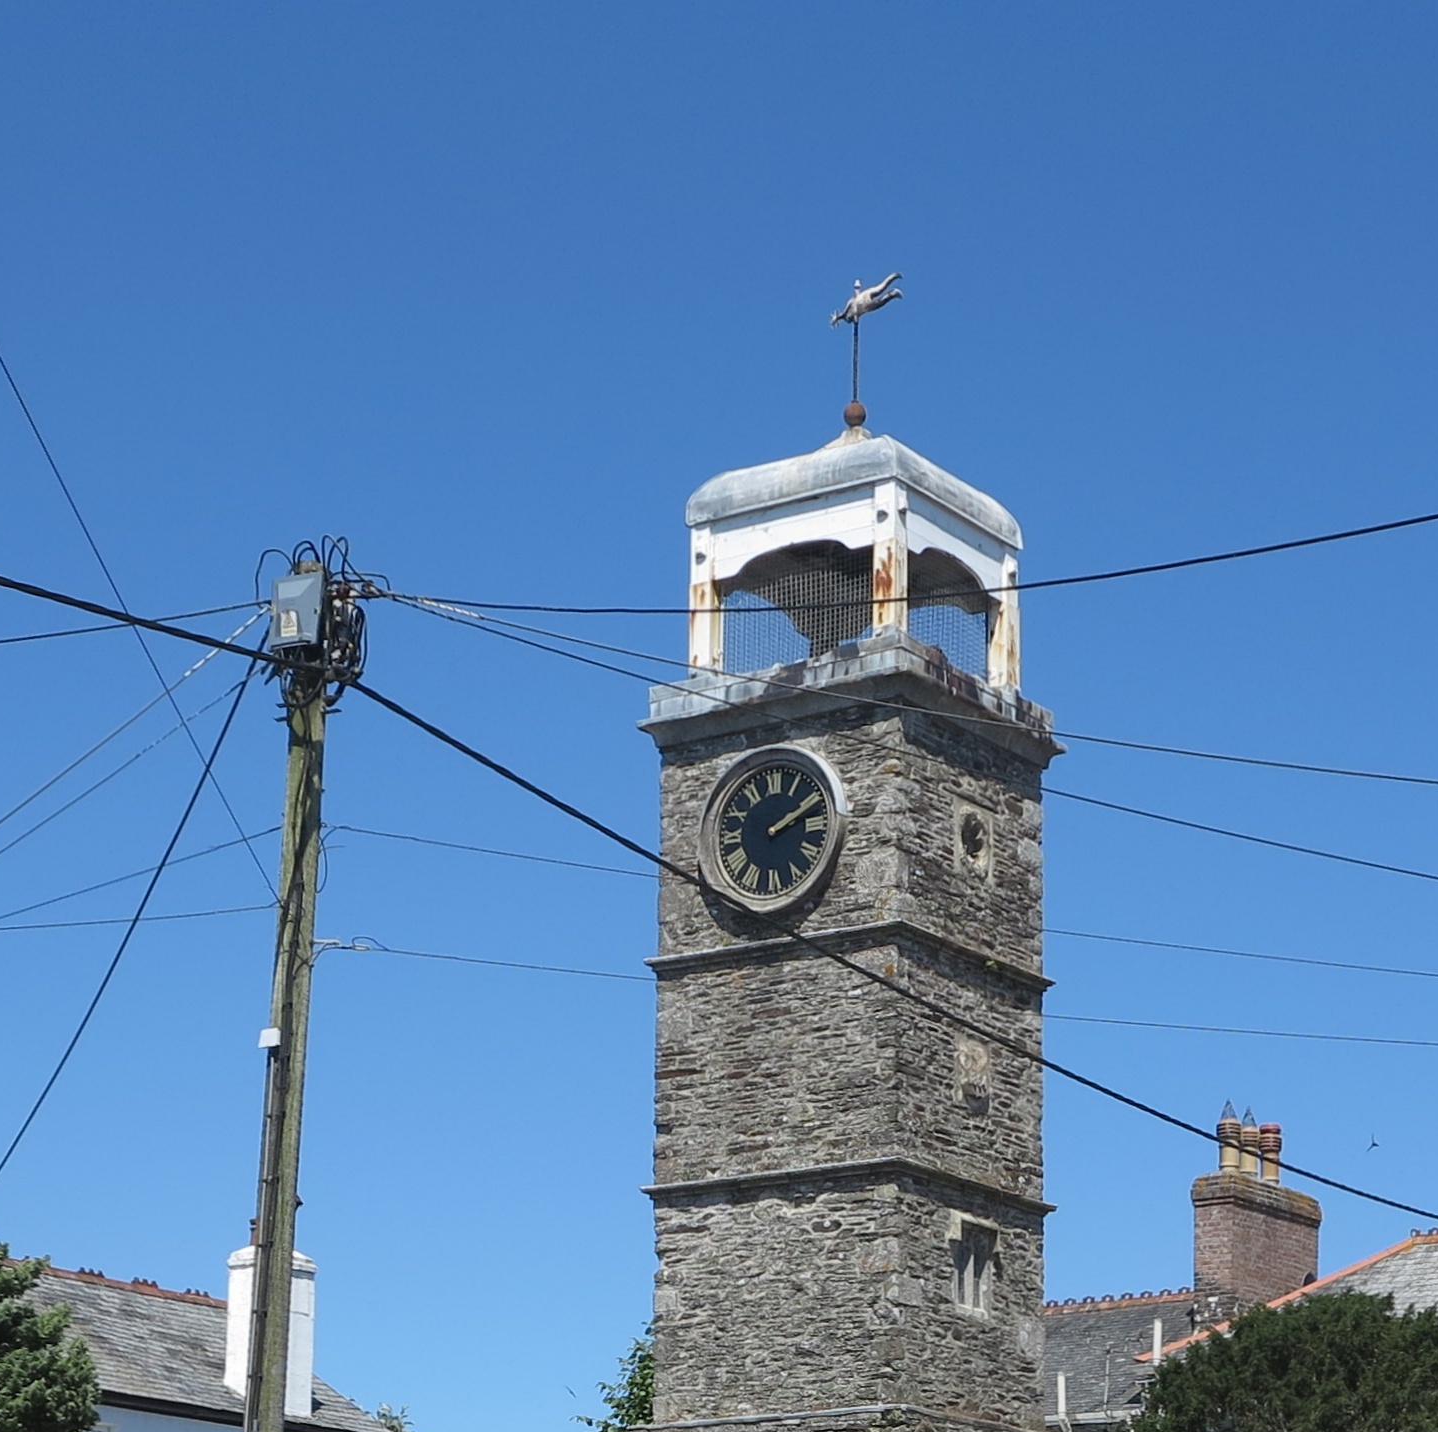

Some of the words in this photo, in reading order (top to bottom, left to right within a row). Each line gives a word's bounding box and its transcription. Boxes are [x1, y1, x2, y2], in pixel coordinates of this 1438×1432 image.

[766, 772, 782, 797] XII
[788, 775, 801, 796] I
[743, 783, 762, 807] XI
[726, 806, 748, 823] X
[805, 816, 825, 833] III
[724, 828, 742, 845] IX
